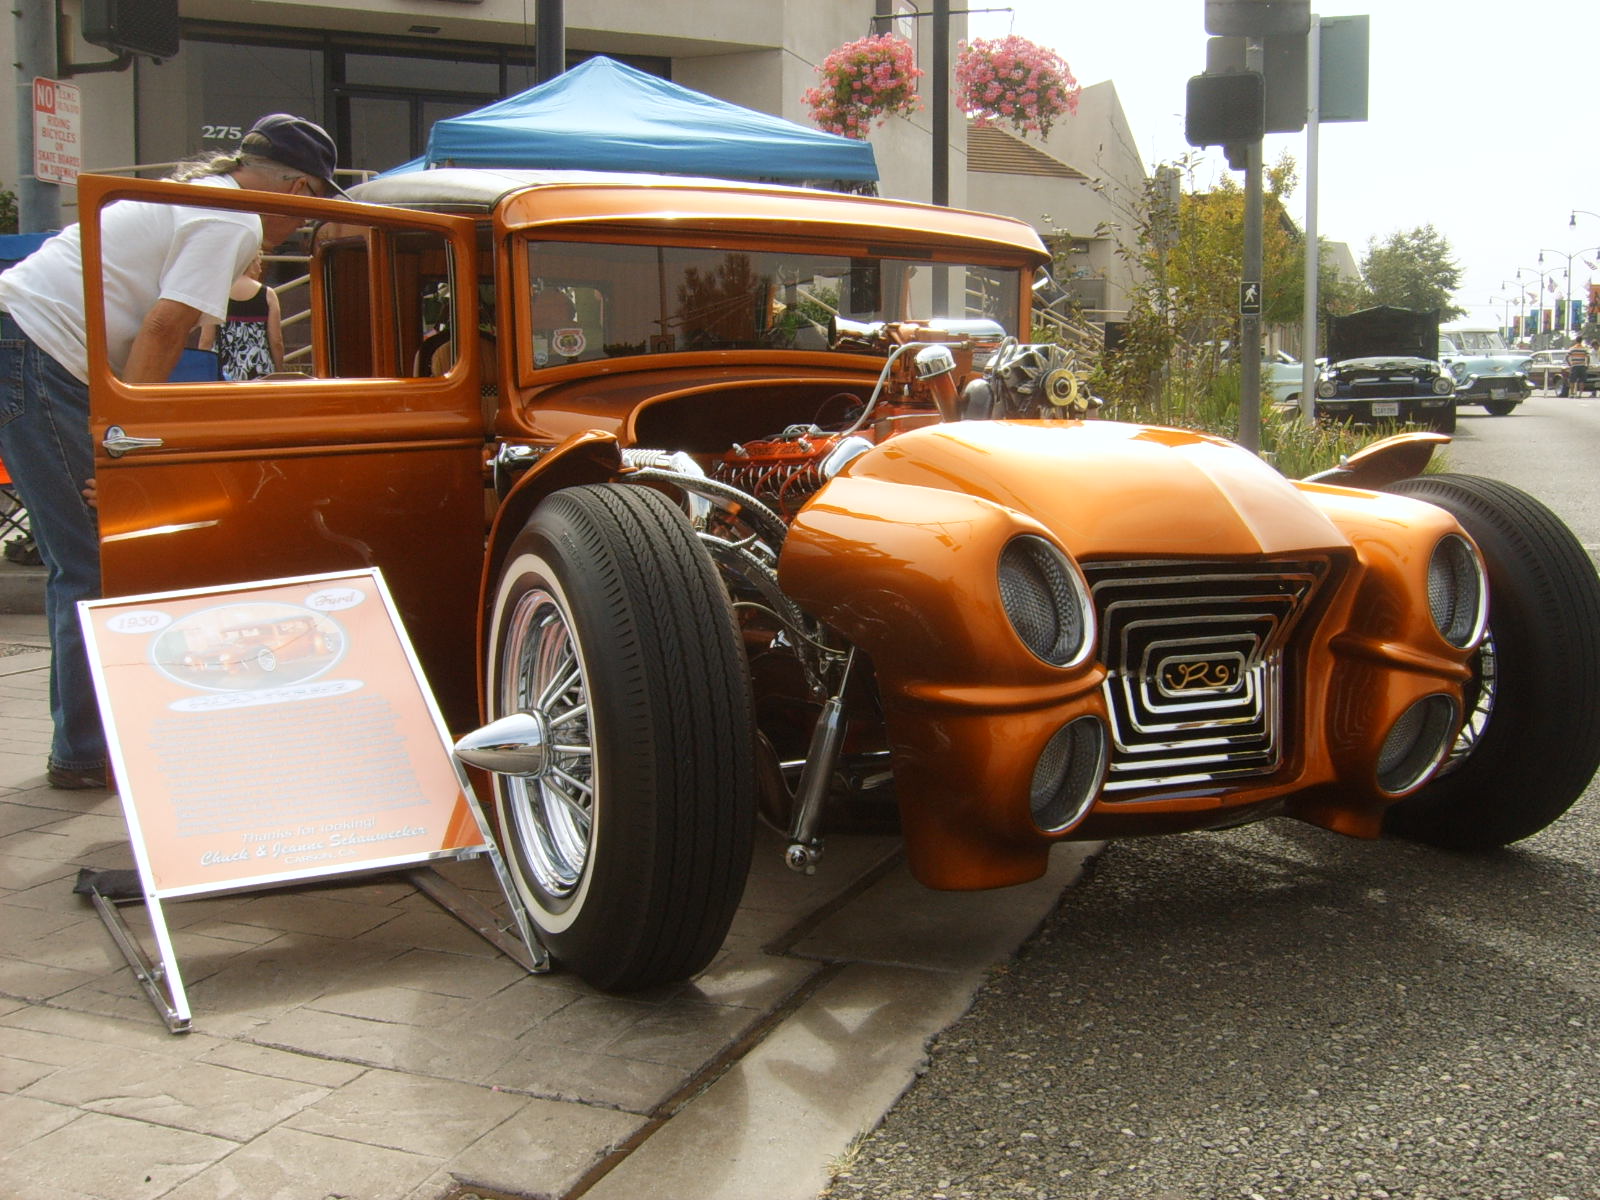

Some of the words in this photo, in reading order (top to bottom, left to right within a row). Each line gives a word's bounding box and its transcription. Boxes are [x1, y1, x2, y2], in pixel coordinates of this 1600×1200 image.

[37, 83, 55, 108] NO
[47, 116, 71, 130] RIDING
[42, 127, 76, 143] BICYCLES
[201, 125, 242, 140] 275
[38, 150, 56, 163] SKATE
[58, 153, 80, 168] BOARDS
[40, 162, 49, 173] ON
[314, 591, 356, 606] Ford
[118, 615, 160, 629] 1930
[240, 829, 292, 843] Thanks
[297, 825, 315, 837] for
[320, 815, 376, 833] looking!
[200, 849, 249, 866] Chuck
[255, 845, 268, 857] &
[271, 840, 325, 858] Jeanne
